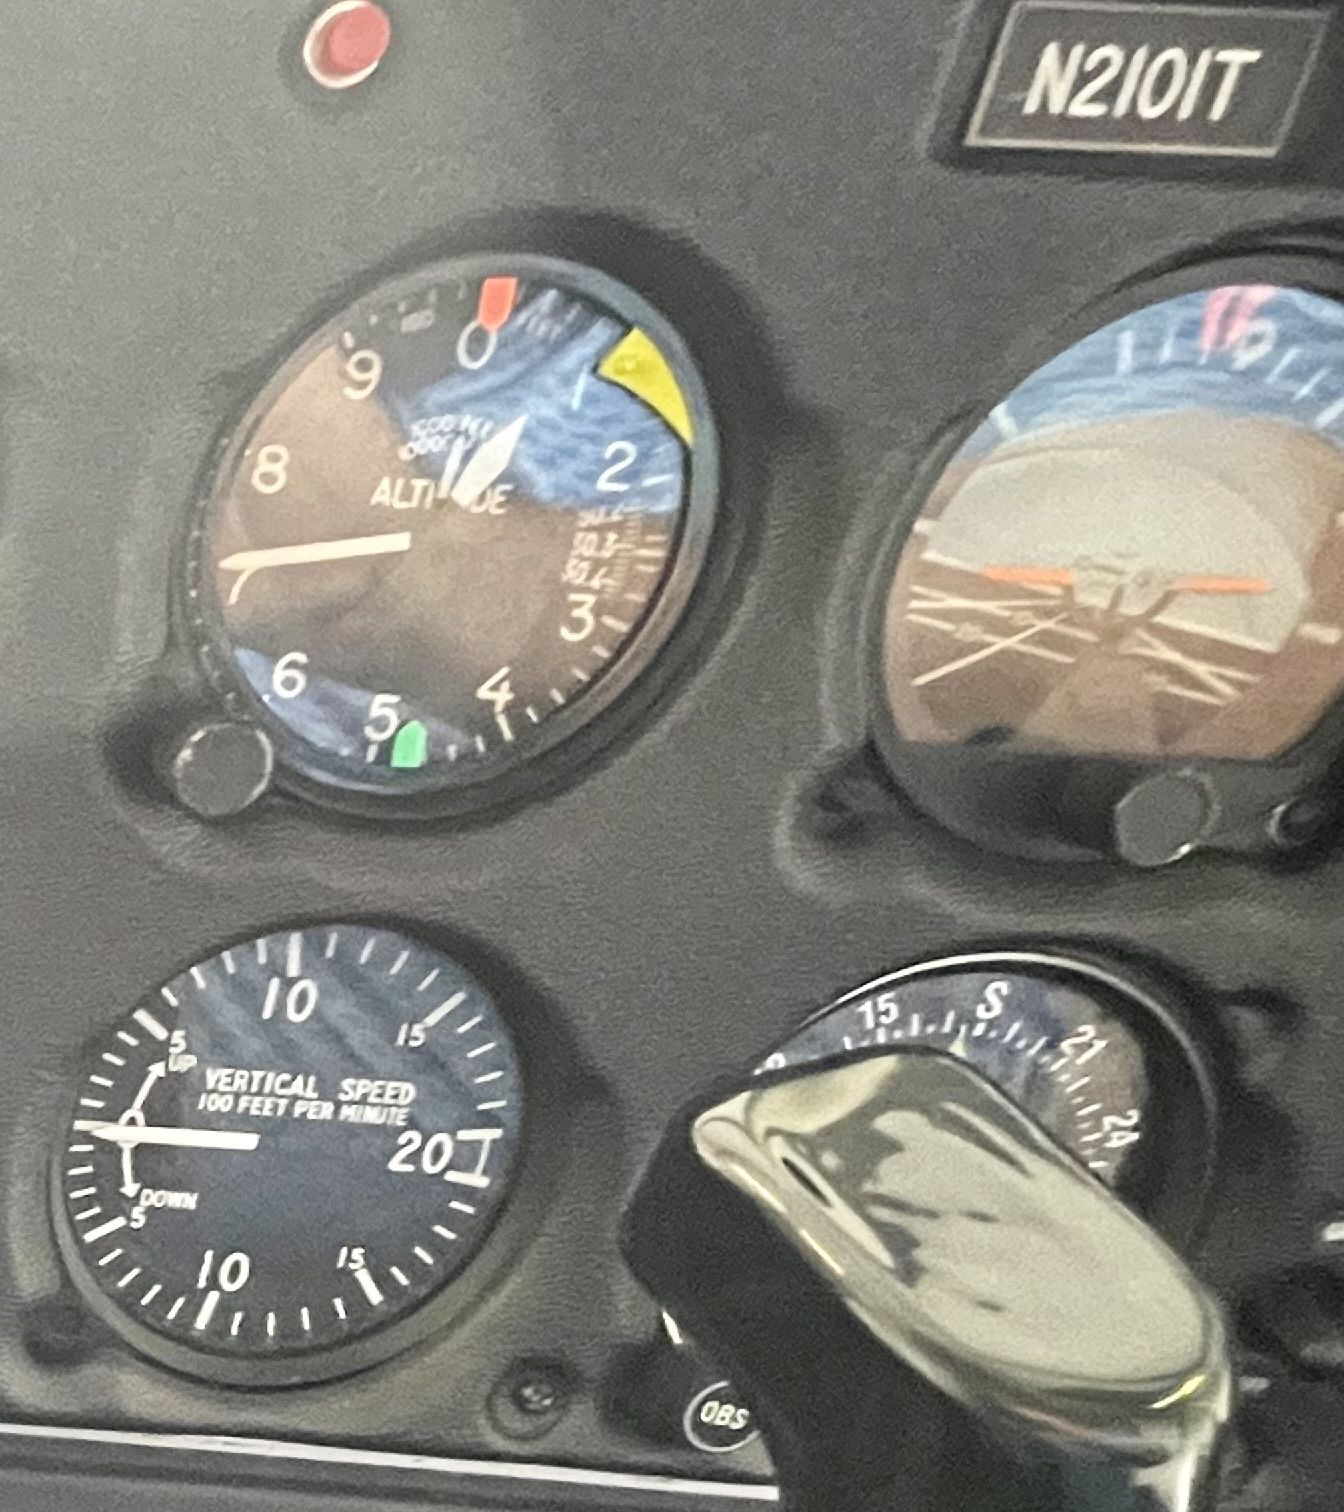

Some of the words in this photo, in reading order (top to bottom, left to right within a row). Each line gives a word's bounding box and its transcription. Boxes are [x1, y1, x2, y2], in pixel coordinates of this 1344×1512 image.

[1022, 40, 1262, 121] N2101T
[457, 318, 498, 371] 0
[344, 349, 382, 400] 9
[571, 366, 590, 412] 1
[250, 444, 290, 494] 8
[596, 440, 638, 492] 2
[369, 476, 514, 515] ALTIDE
[560, 592, 597, 641] 3
[271, 652, 308, 699] 6
[476, 666, 514, 712] 4
[363, 693, 402, 742] 5
[261, 976, 319, 1023] 10
[856, 992, 900, 1030] 15
[974, 979, 1010, 1020] S
[168, 1030, 187, 1055] 5
[396, 1023, 427, 1048] 15
[1060, 1023, 1108, 1066] 21
[168, 1053, 198, 1073] UP
[205, 1067, 320, 1100] VERTICAL
[337, 1078, 417, 1103] SPEED
[197, 1093, 233, 1113] 100
[235, 1096, 289, 1118] FEET
[293, 1099, 336, 1121] PER
[338, 1103, 410, 1128] MINUTE
[1100, 1108, 1141, 1149] 24
[387, 1129, 455, 1176] 20
[129, 1208, 147, 1229] 5
[139, 1190, 198, 1211] DOWN
[196, 1249, 250, 1293] 10
[336, 1245, 367, 1270] 15
[699, 1401, 750, 1433] OBS
